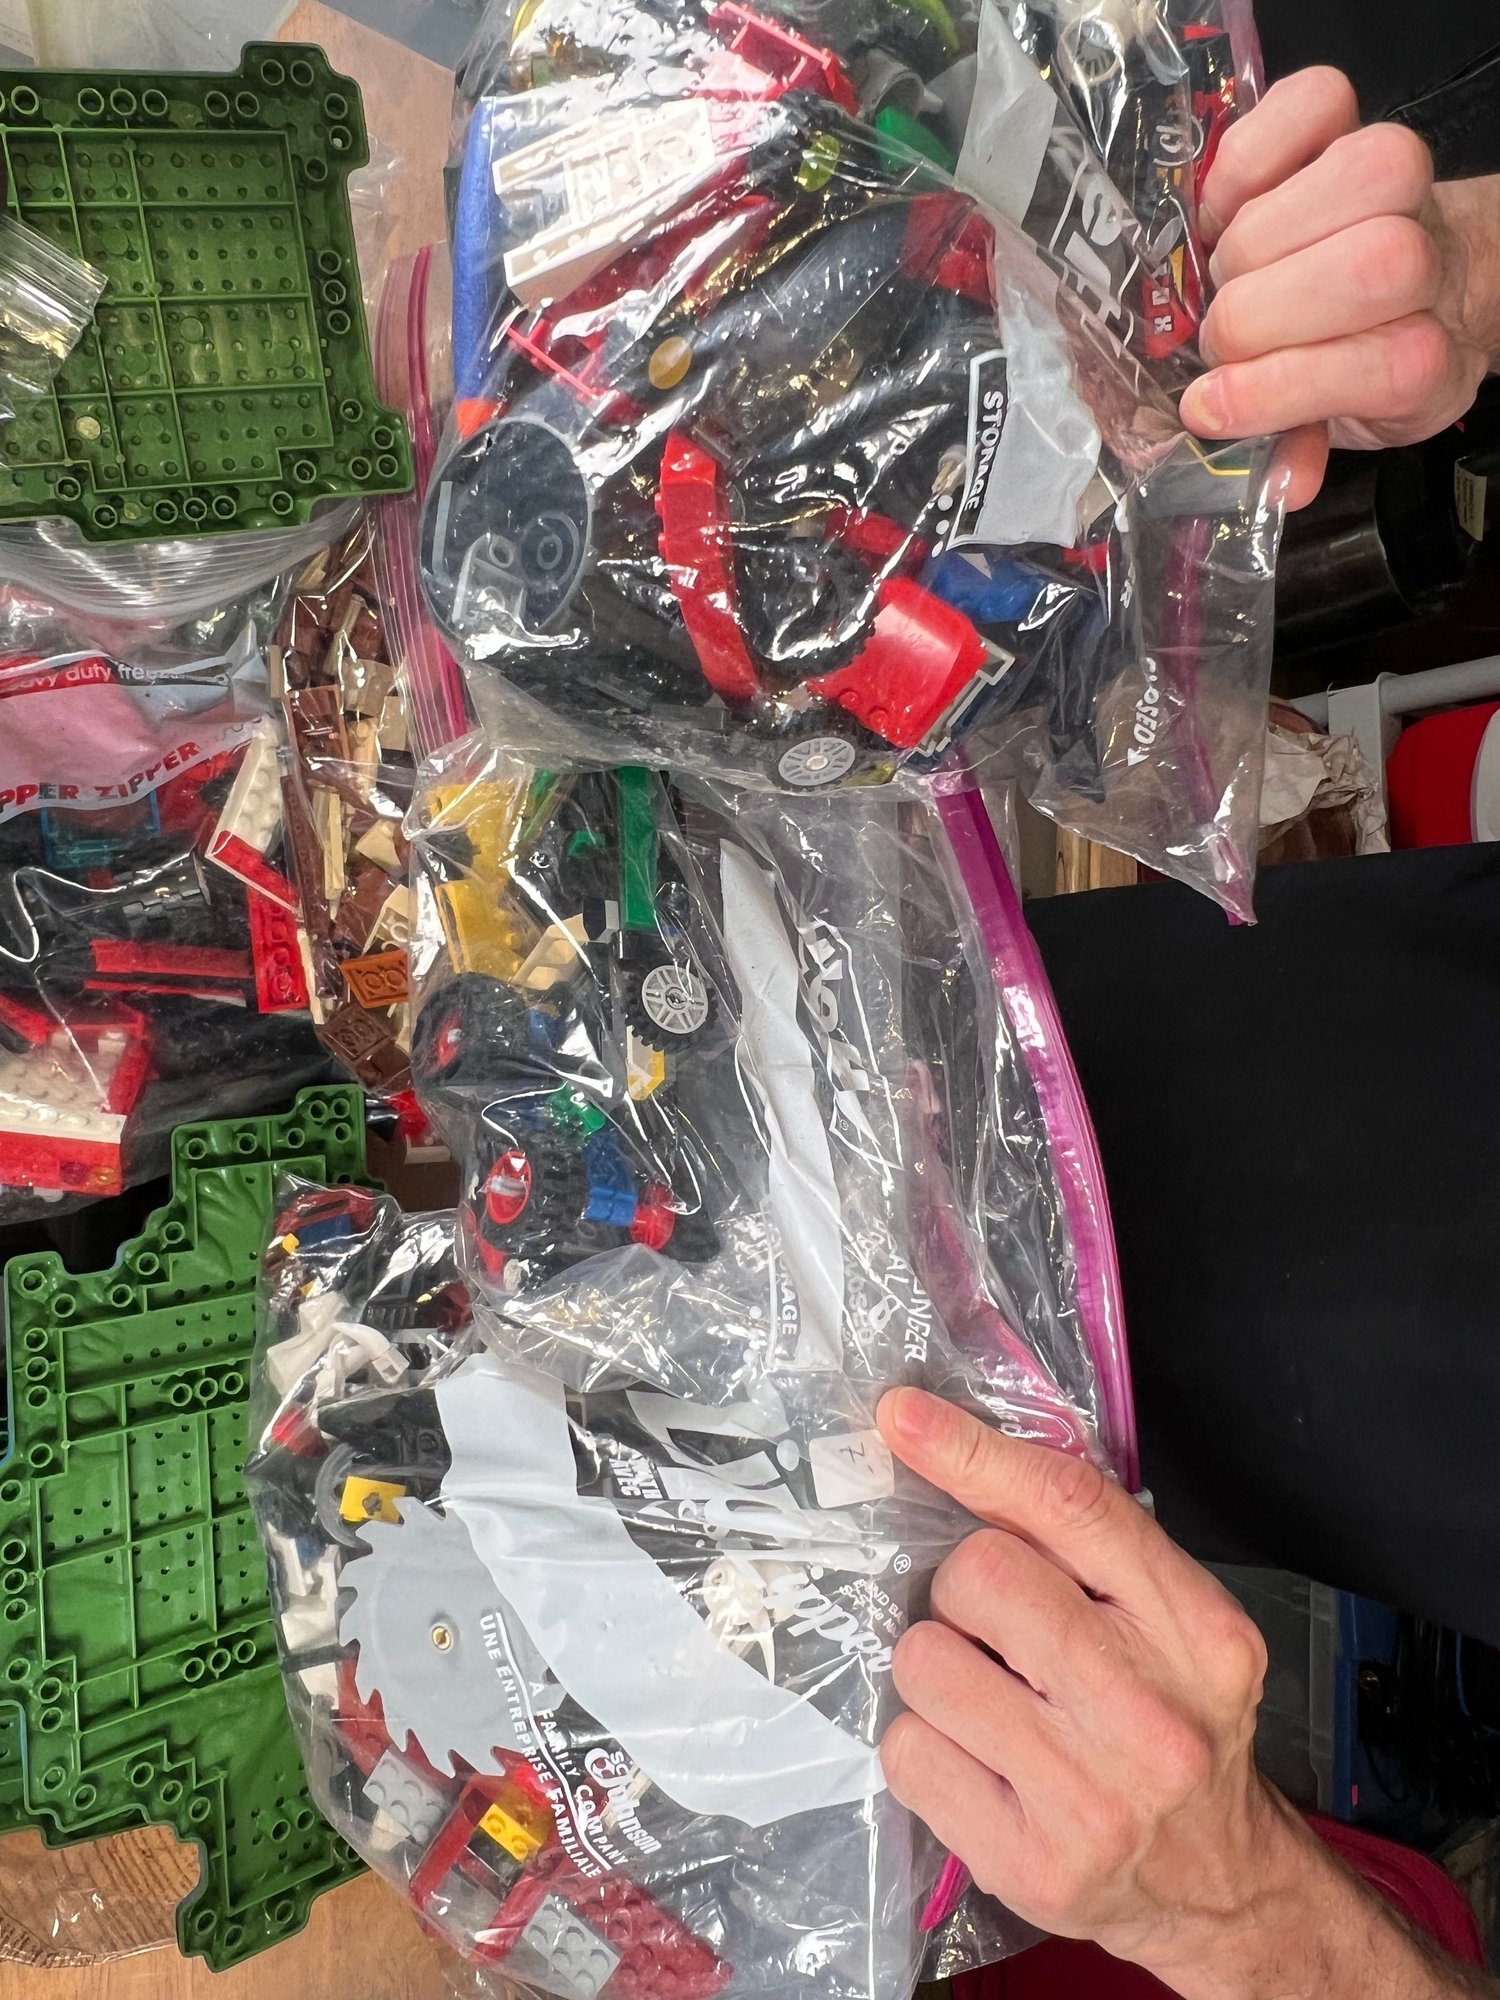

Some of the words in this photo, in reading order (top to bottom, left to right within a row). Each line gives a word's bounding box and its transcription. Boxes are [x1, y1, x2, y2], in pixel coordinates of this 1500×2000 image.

[65, 662, 113, 682] duty
[94, 741, 201, 799] ZIPPER
[479, 1612, 503, 1660] UNE
[495, 1665, 555, 1784] ENTREPRISE
[544, 1786, 602, 1879] FAMILIALE
[527, 1681, 546, 1698] A
[573, 1784, 630, 1867] COMPANY
